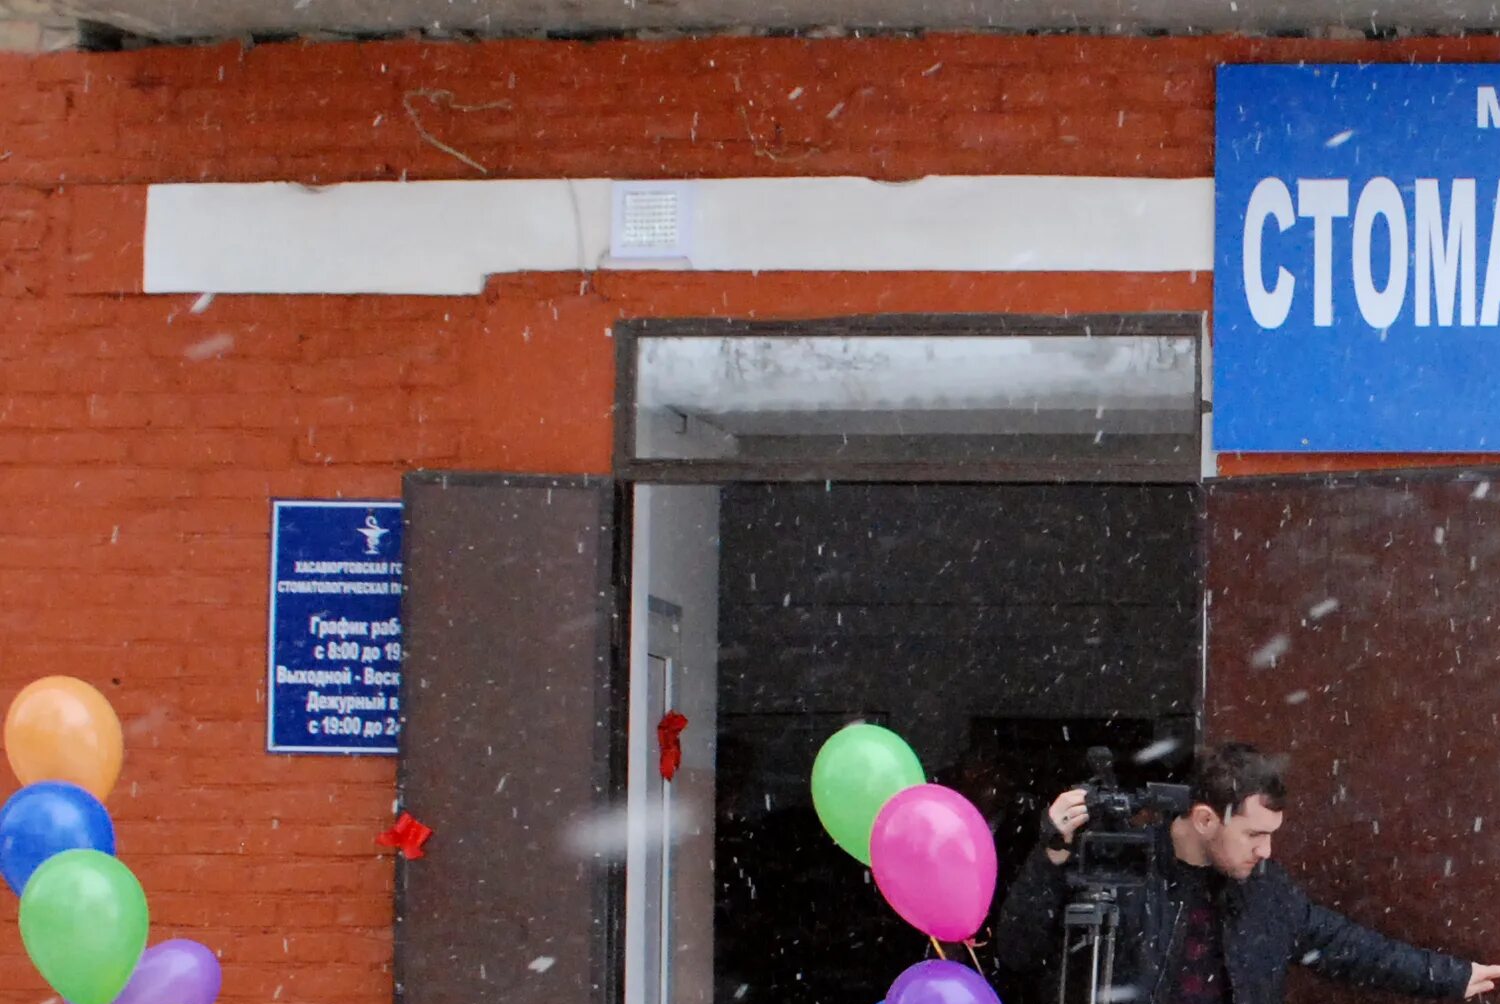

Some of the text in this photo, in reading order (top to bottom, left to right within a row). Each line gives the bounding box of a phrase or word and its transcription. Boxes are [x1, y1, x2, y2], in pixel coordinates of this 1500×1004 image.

[278, 581, 388, 594] СТОМАТОЛОГИЧЕСКАЯ
[310, 616, 368, 639] График
[314, 645, 325, 660] с
[327, 641, 359, 660] 8:00
[361, 646, 380, 663] до
[276, 665, 351, 687] Выходной
[306, 691, 386, 714] Дежурный
[308, 720, 319, 735] с
[322, 716, 361, 735] 19:00
[363, 721, 382, 738] до
